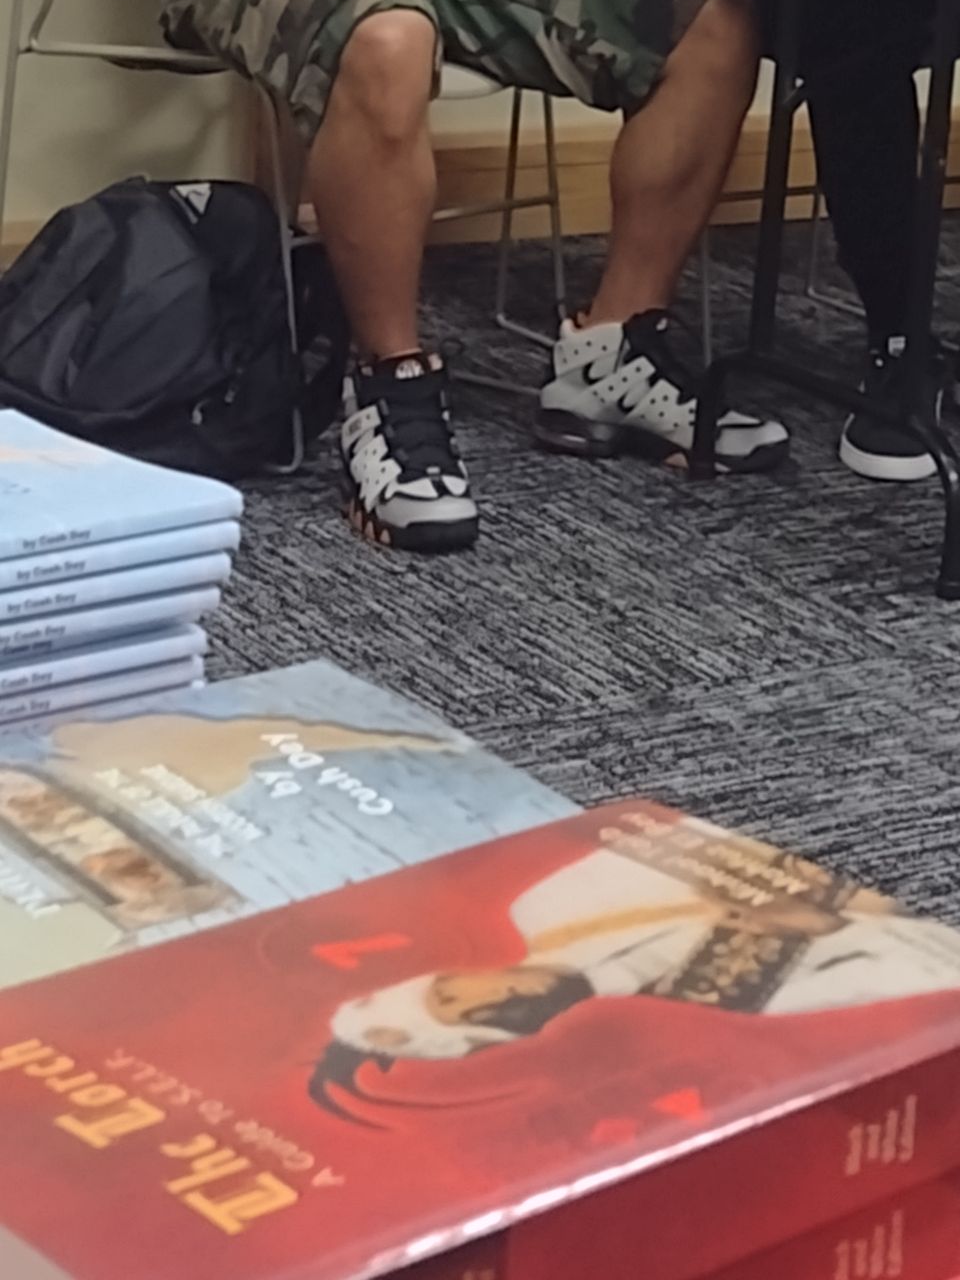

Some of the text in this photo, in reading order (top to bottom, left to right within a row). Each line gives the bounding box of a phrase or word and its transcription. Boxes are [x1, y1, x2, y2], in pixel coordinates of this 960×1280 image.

[255, 770, 302, 799] by
[317, 766, 393, 816] Cush
[0, 1037, 298, 1236] The Torch
[312, 1165, 346, 1188] A
